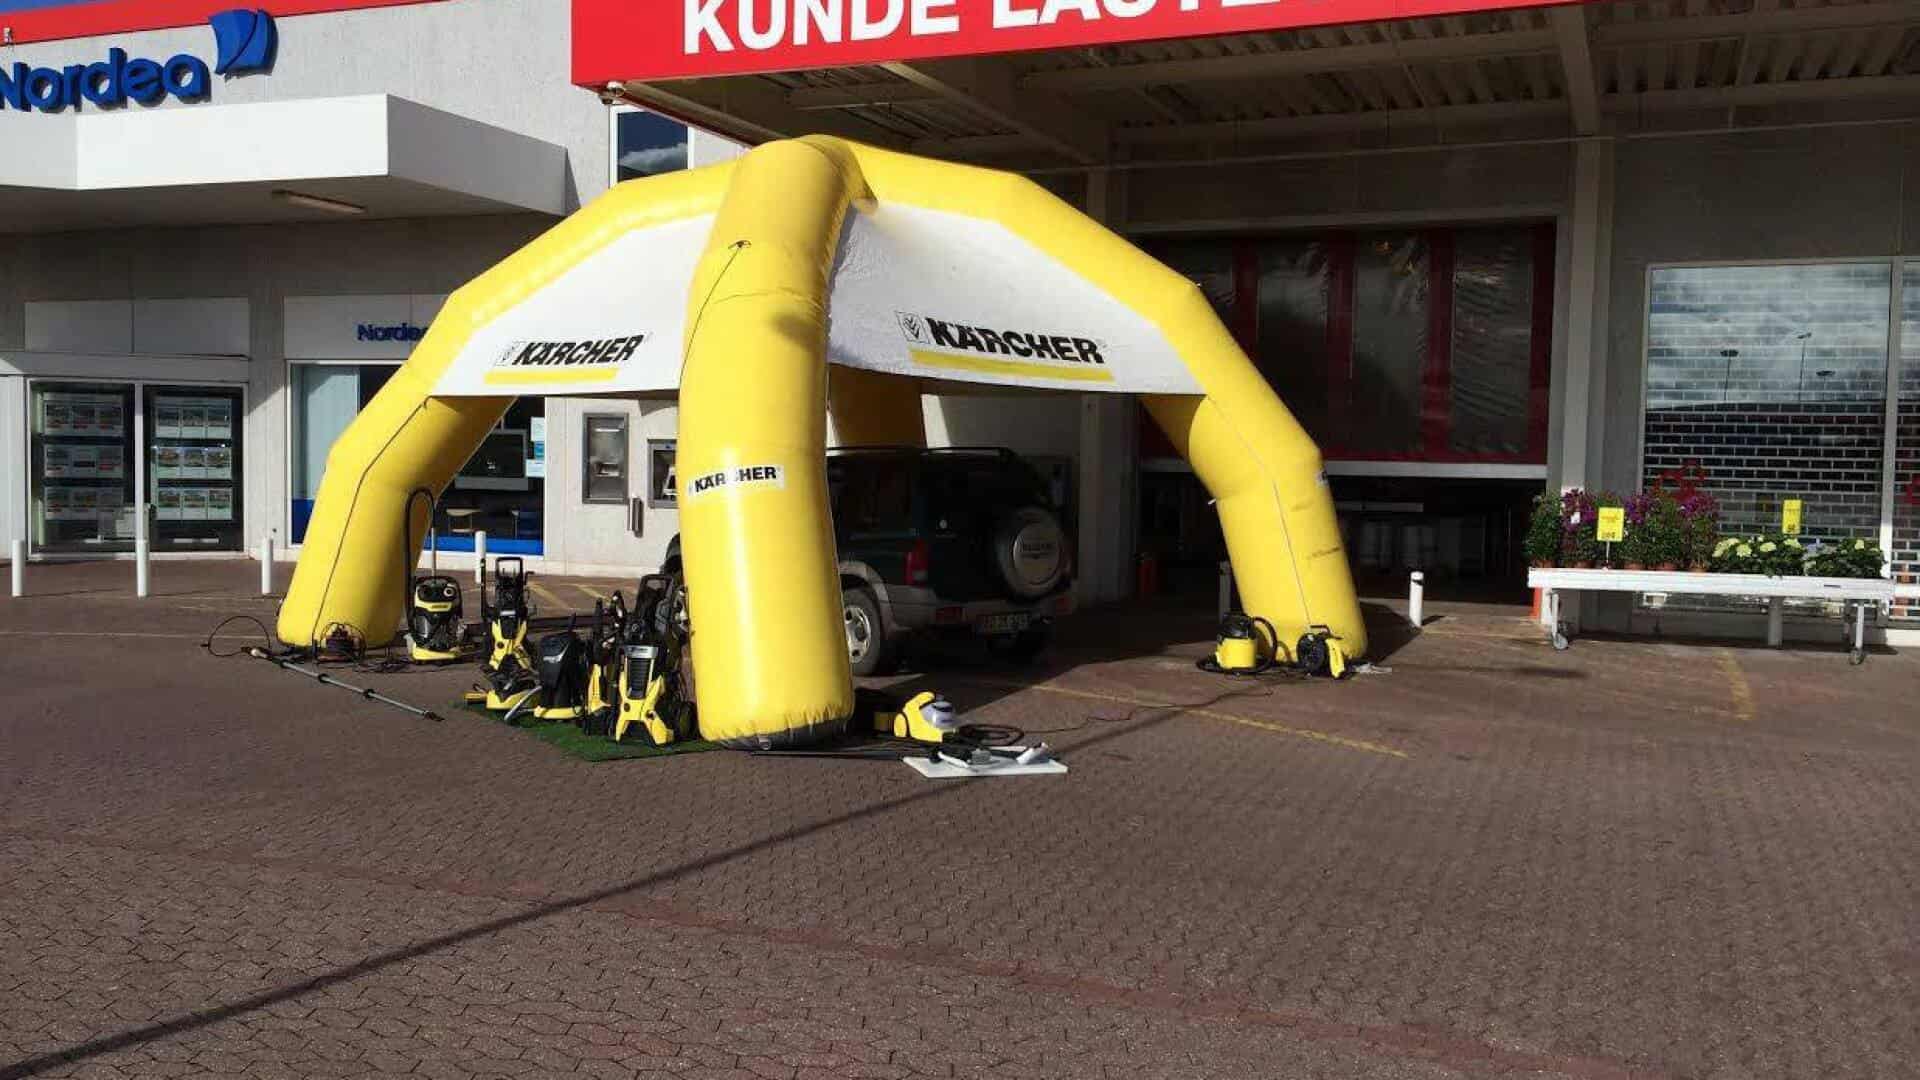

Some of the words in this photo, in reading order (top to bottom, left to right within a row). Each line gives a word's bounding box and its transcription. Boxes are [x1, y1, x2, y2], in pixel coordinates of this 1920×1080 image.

[0, 47, 211, 113] Nordea
[512, 334, 644, 365] KÄRCHER
[925, 317, 1104, 363] KÄRCHER
[695, 466, 777, 492] KÄRHER
